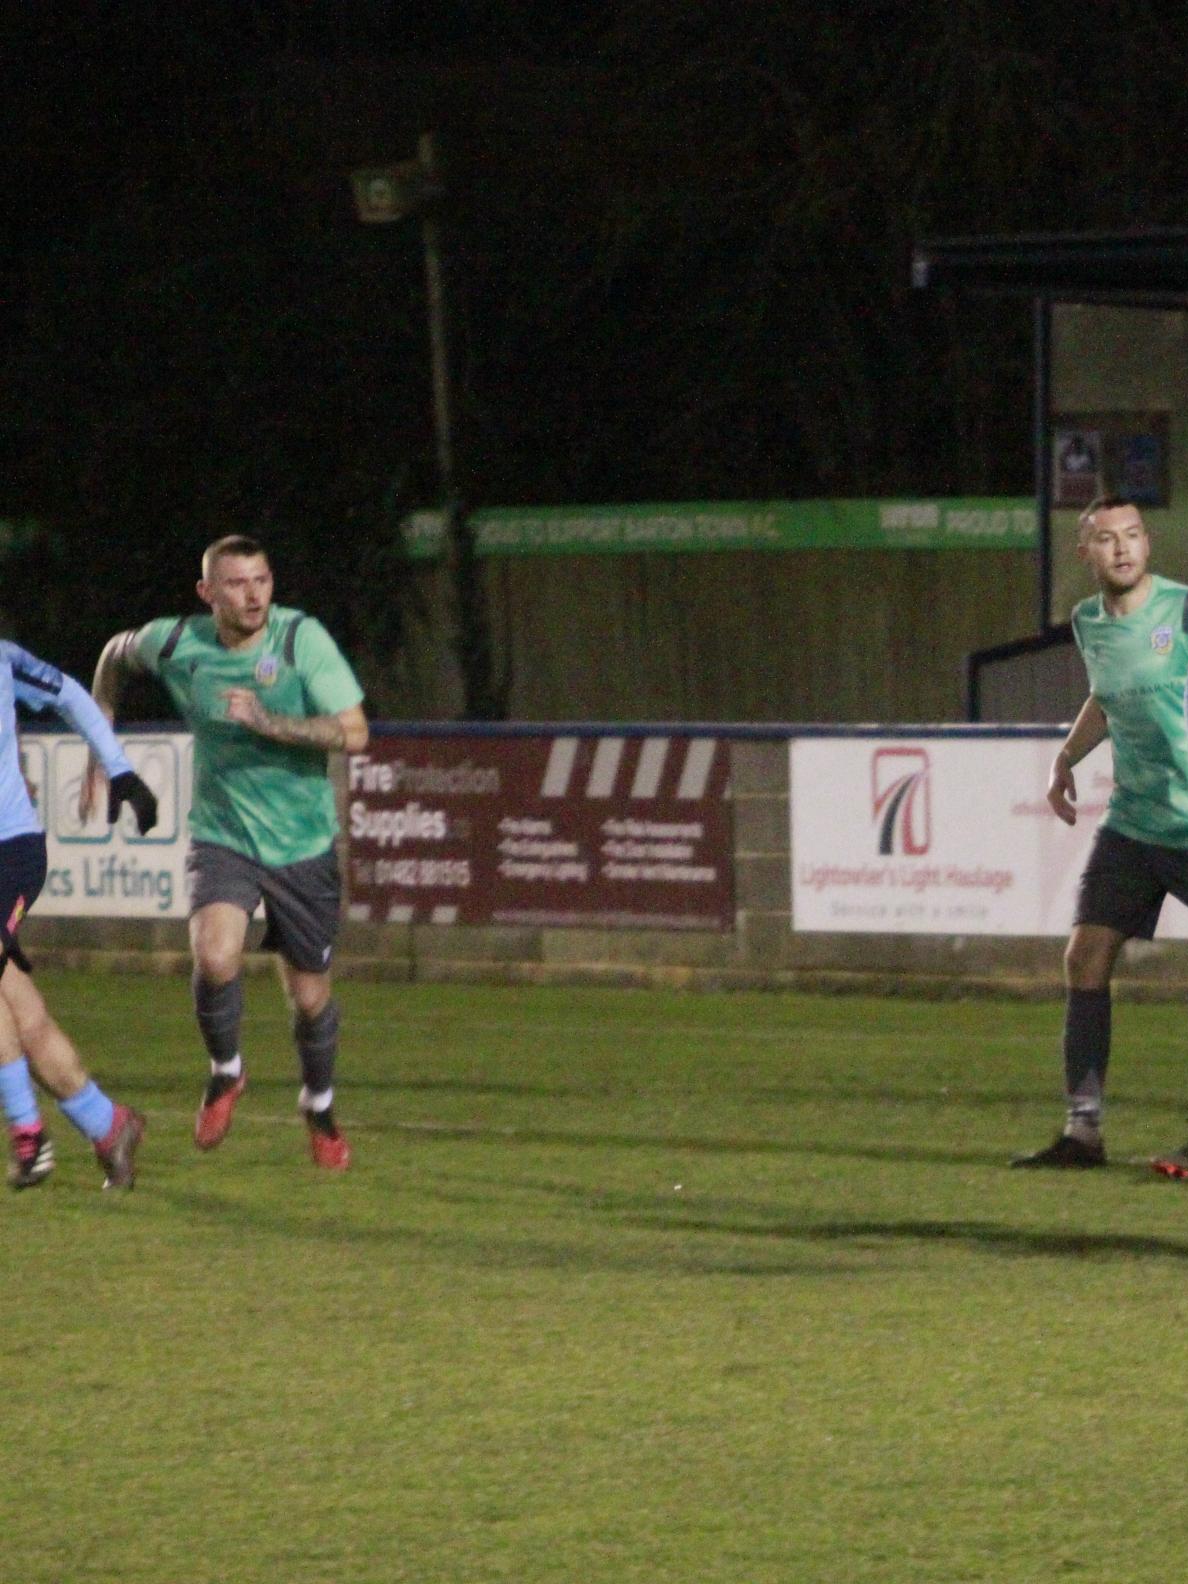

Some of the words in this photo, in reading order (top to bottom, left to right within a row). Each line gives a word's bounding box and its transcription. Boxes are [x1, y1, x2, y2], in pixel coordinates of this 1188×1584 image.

[349, 801, 446, 847] Supplies
[48, 866, 74, 897] cs
[83, 856, 173, 911] Lifting
